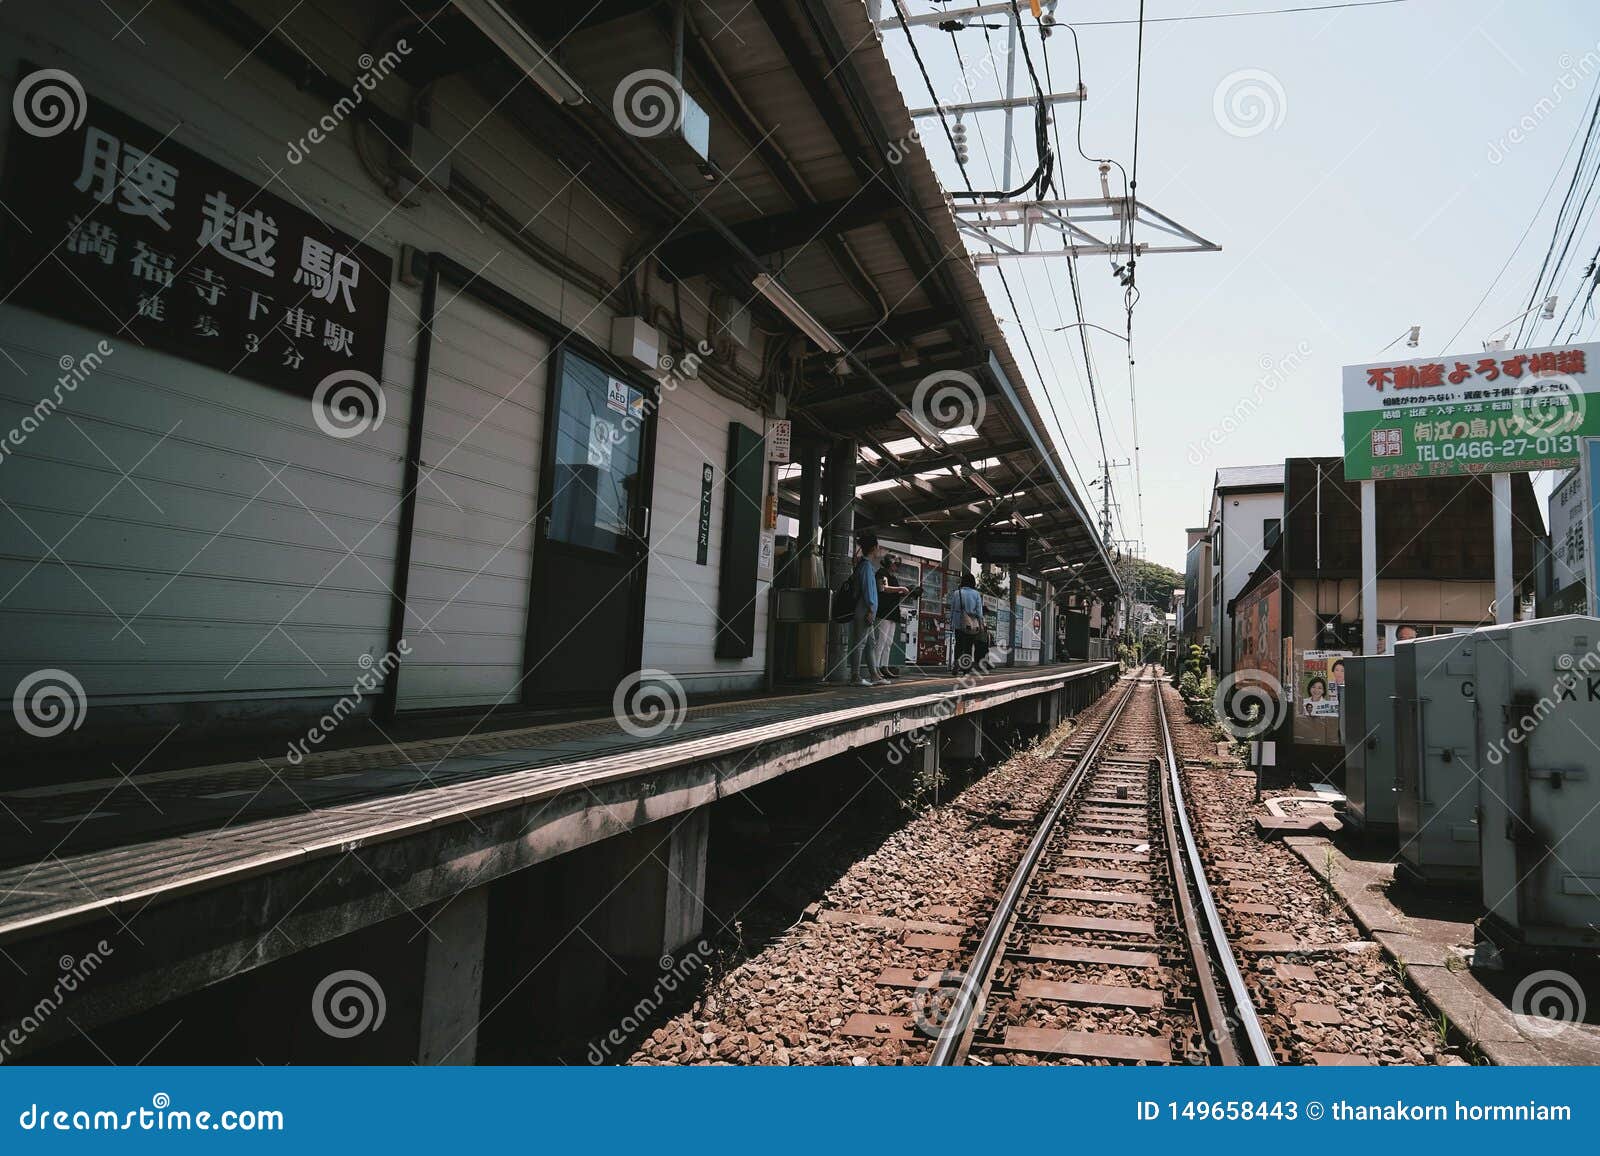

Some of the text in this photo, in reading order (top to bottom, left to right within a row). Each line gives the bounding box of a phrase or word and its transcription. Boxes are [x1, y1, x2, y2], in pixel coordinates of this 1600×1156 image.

[73, 125, 360, 313] 腰越駅
[66, 214, 355, 358] 満福寺下車駅
[136, 294, 304, 369] 徒歩3分
[1367, 350, 1586, 391] 不動産よろず相談
[609, 391, 626, 403] AED
[1416, 434, 1580, 461] TEL 0466-27-0131
[1461, 681, 1474, 698] C
